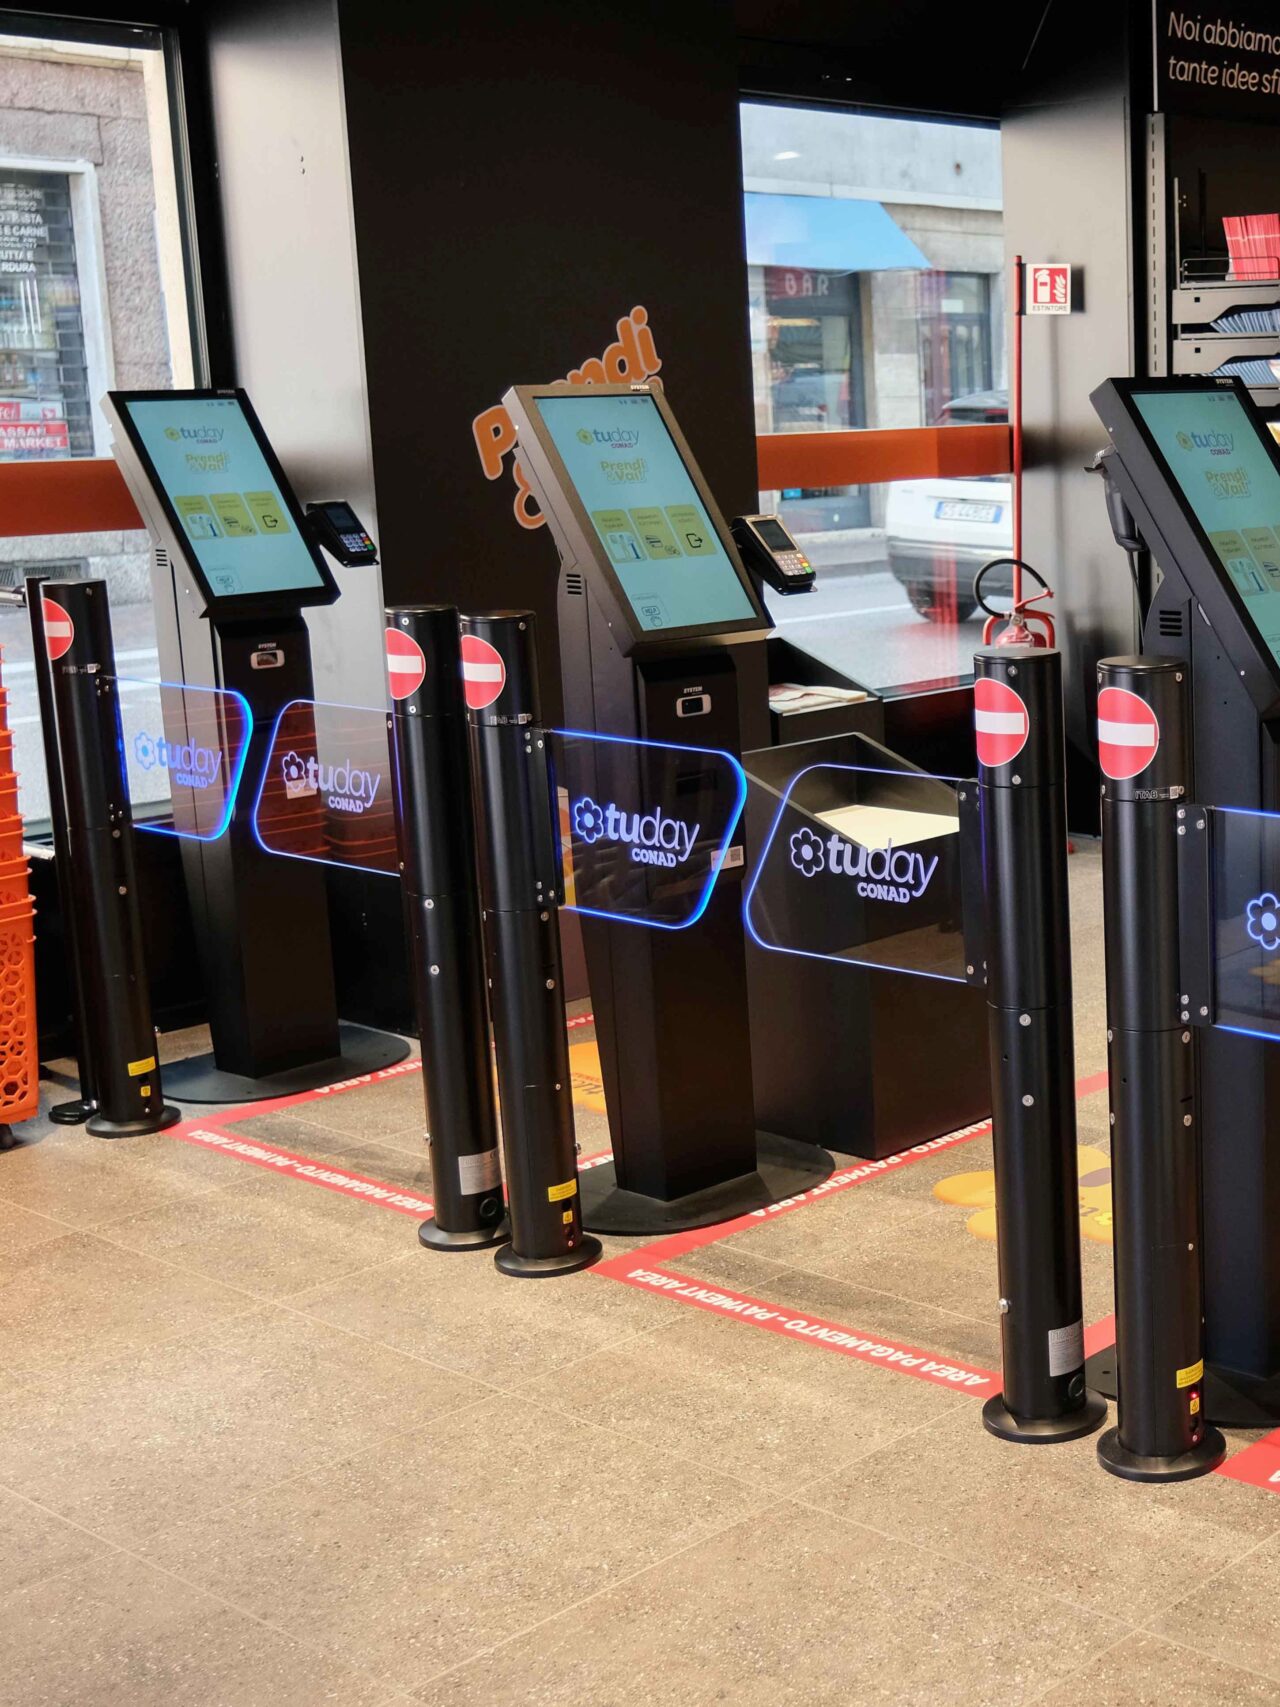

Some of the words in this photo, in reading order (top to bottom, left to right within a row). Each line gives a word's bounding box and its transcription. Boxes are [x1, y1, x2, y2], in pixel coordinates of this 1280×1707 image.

[1168, 11, 1200, 41] Noi
[1168, 55, 1219, 86] tante
[1222, 65, 1258, 92] idee
[784, 272, 829, 297] BAR
[1032, 304, 1067, 312] ESTINTORE
[180, 425, 224, 442] tuday
[593, 427, 639, 446] tuday
[1190, 429, 1234, 452] tuday
[156, 735, 222, 783] tuday
[176, 773, 208, 788] CONAD
[306, 755, 381, 808] tuday
[328, 795, 364, 813] CONAD
[605, 803, 700, 862] tuday
[631, 848, 677, 867] CONAD
[827, 834, 938, 898] tuday
[857, 881, 911, 903] CONAD
[911, 1117, 992, 1155] AMENTO
[808, 1153, 902, 1194] PAYMENT
[626, 1268, 679, 1293] AREA
[679, 1286, 770, 1322] PAYMENT
[784, 1318, 929, 1370] PAGAMENTO
[930, 1362, 991, 1388] AREA
